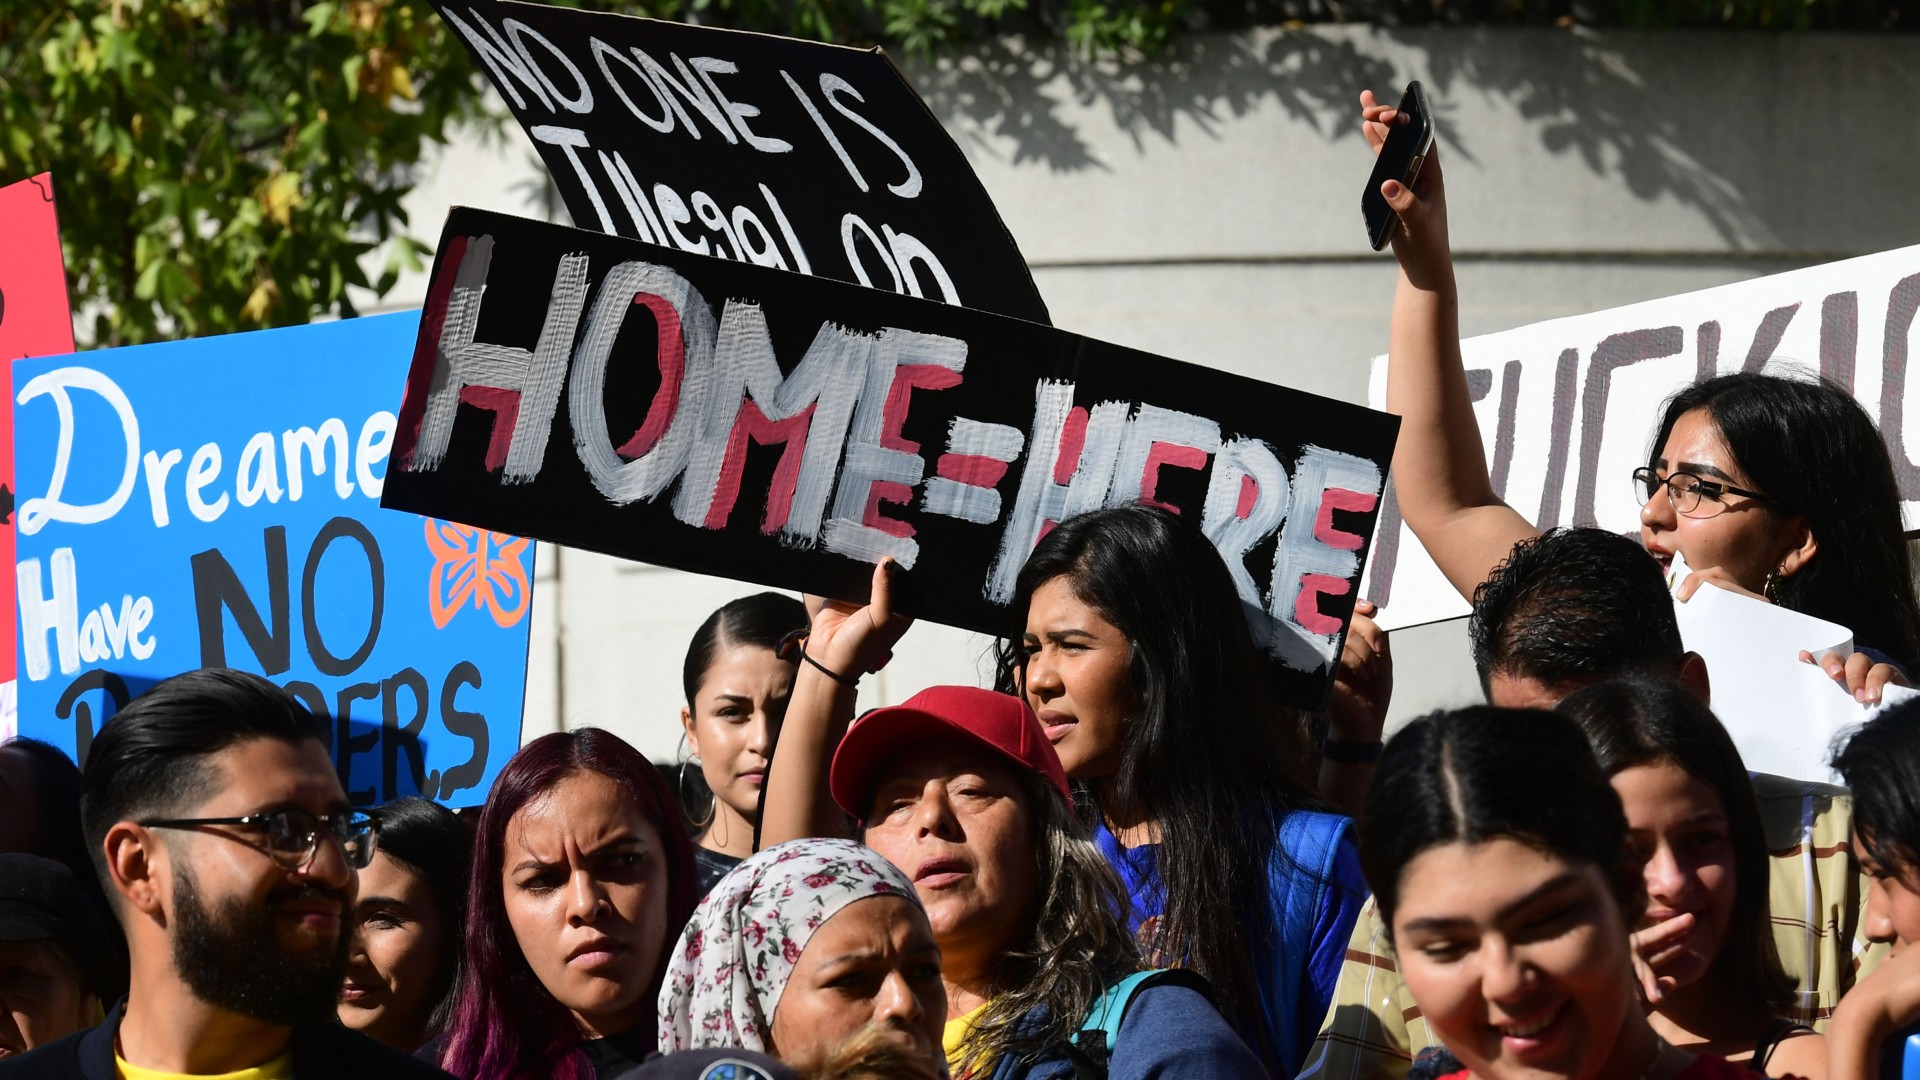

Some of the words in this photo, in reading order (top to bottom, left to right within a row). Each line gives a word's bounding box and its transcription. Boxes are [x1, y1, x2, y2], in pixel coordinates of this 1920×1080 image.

[442, 5, 593, 114] NO
[590, 35, 793, 154] ONE
[781, 70, 922, 198] IS
[16, 366, 400, 535] Dreame
[16, 547, 156, 681] Have
[191, 516, 386, 677] NO
